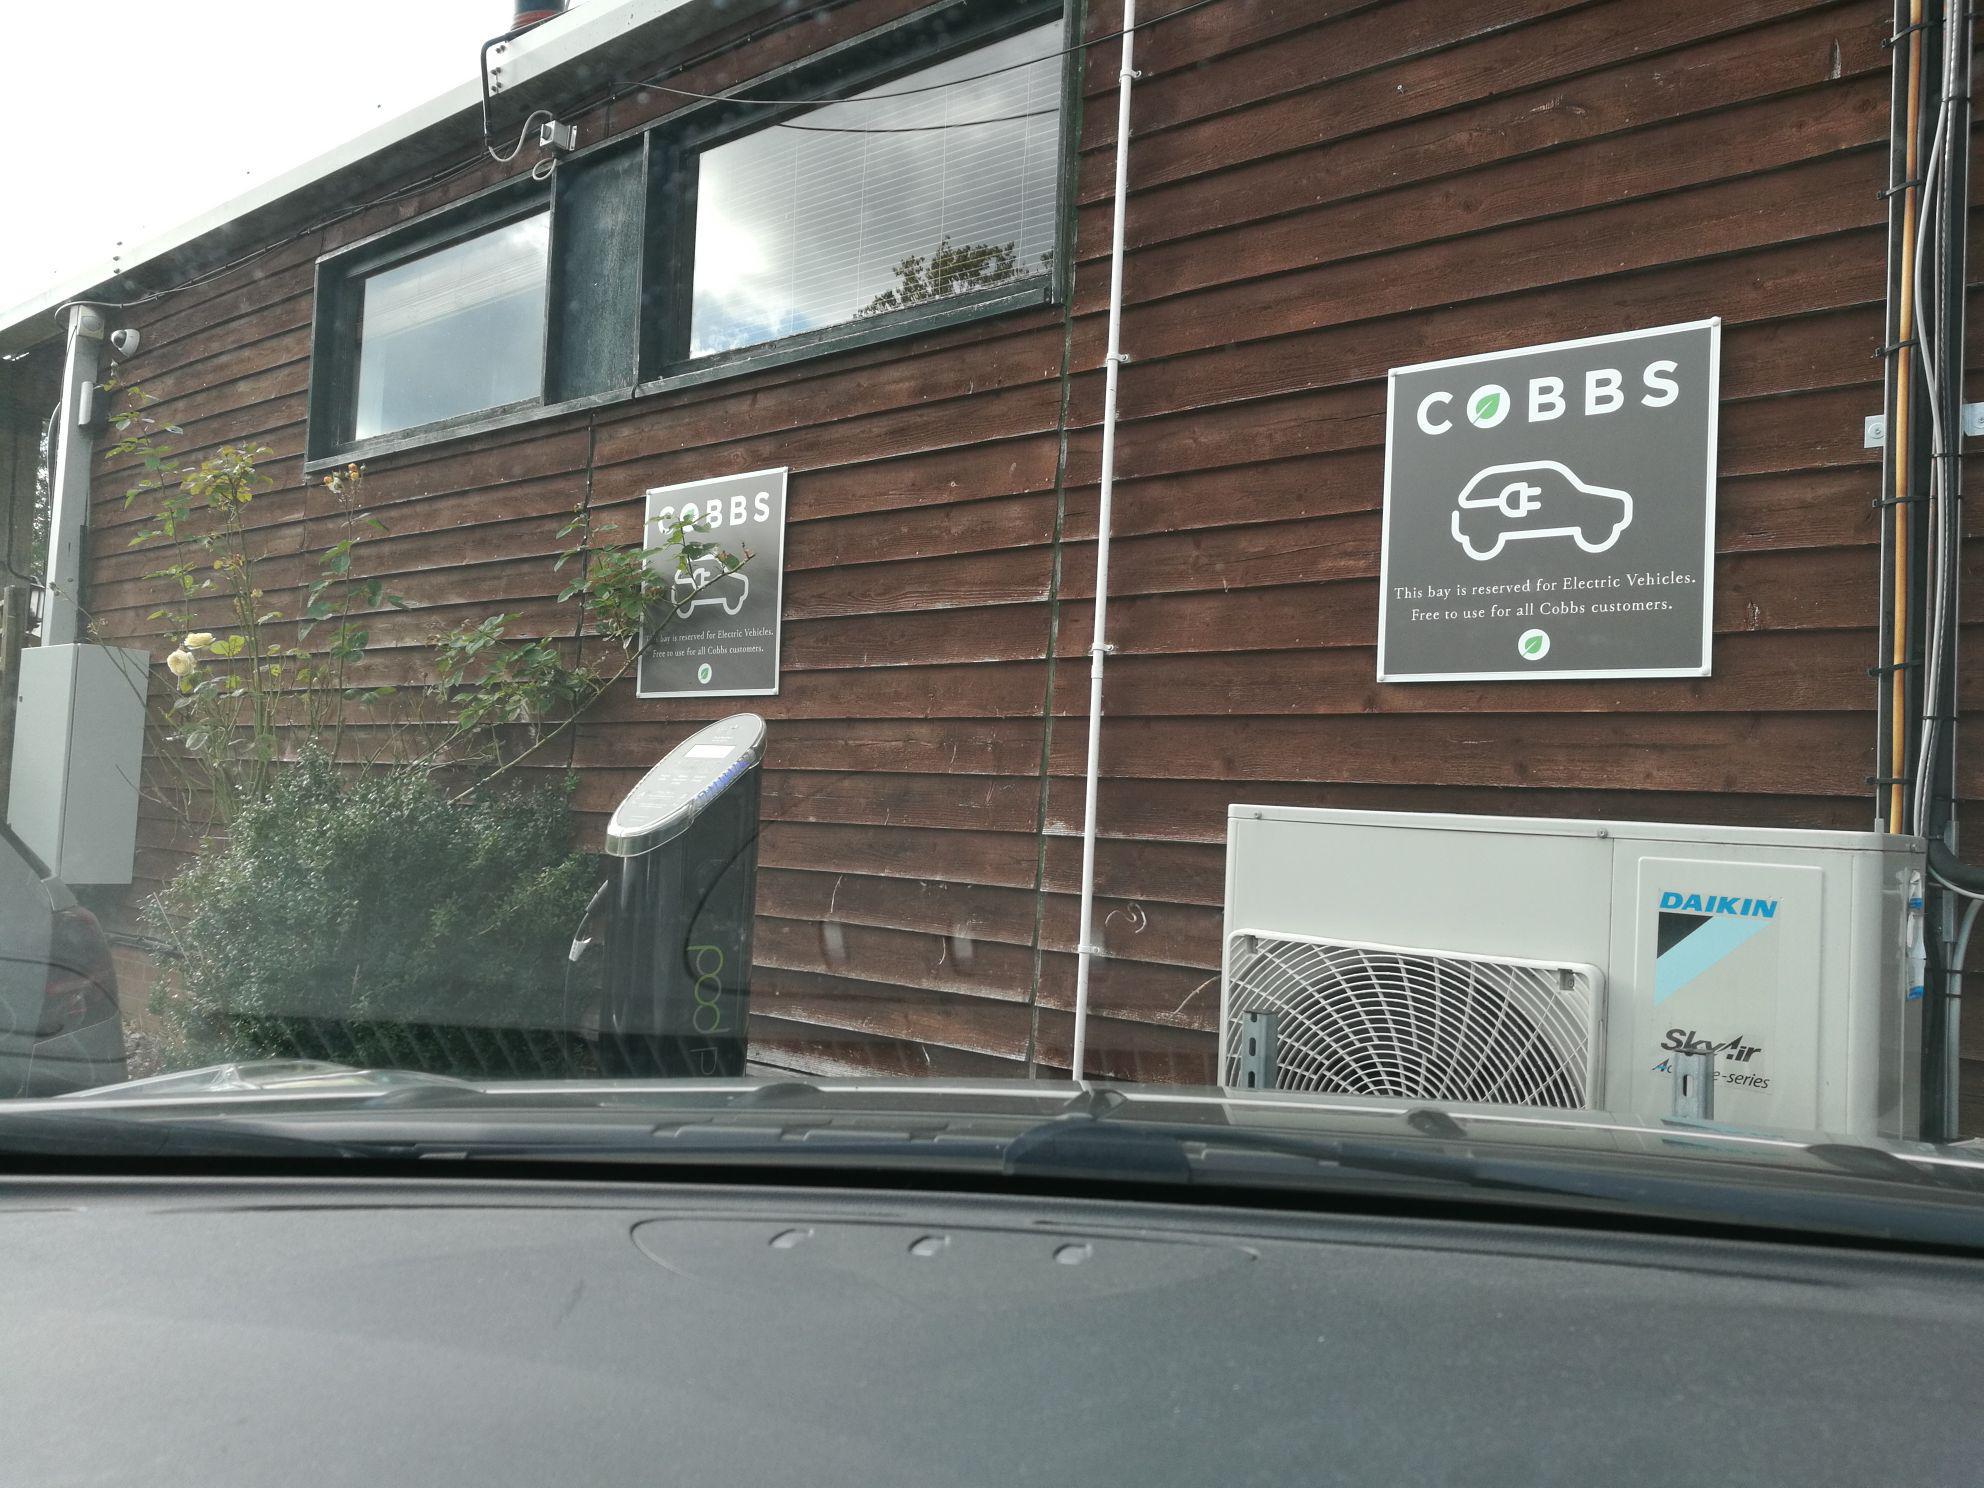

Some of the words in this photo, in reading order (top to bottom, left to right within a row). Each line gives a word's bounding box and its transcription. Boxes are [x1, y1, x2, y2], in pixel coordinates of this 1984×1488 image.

[1416, 360, 1680, 436] COBBS
[657, 491, 770, 535] COBBS
[1394, 585, 1423, 600] This
[1428, 585, 1452, 600] bay
[1457, 584, 1467, 596] is
[1472, 578, 1531, 595] reserved
[1536, 578, 1558, 592] for
[1563, 575, 1621, 590] Electric
[1626, 570, 1697, 587] Vehicles.
[1411, 608, 1440, 621] Free
[1445, 610, 1458, 620] to
[1463, 609, 1485, 619] use
[1491, 604, 1512, 618] for
[1516, 603, 1534, 616] all
[1540, 600, 1585, 615] Cobbs
[1591, 600, 1673, 613] customers.
[672, 633, 677, 642] is
[679, 631, 705, 641] reserved
[706, 630, 716, 640] for
[717, 629, 743, 639] Electric
[744, 627, 774, 637] Vehicles.
[652, 649, 666, 658] Free
[687, 647, 696, 656] for
[697, 646, 706, 656] all
[707, 645, 728, 655] Cobbs
[729, 646, 764, 654] customers.
[1659, 891, 1778, 918] DAIKIN
[1652, 1058, 1770, 1089] Ace-series
